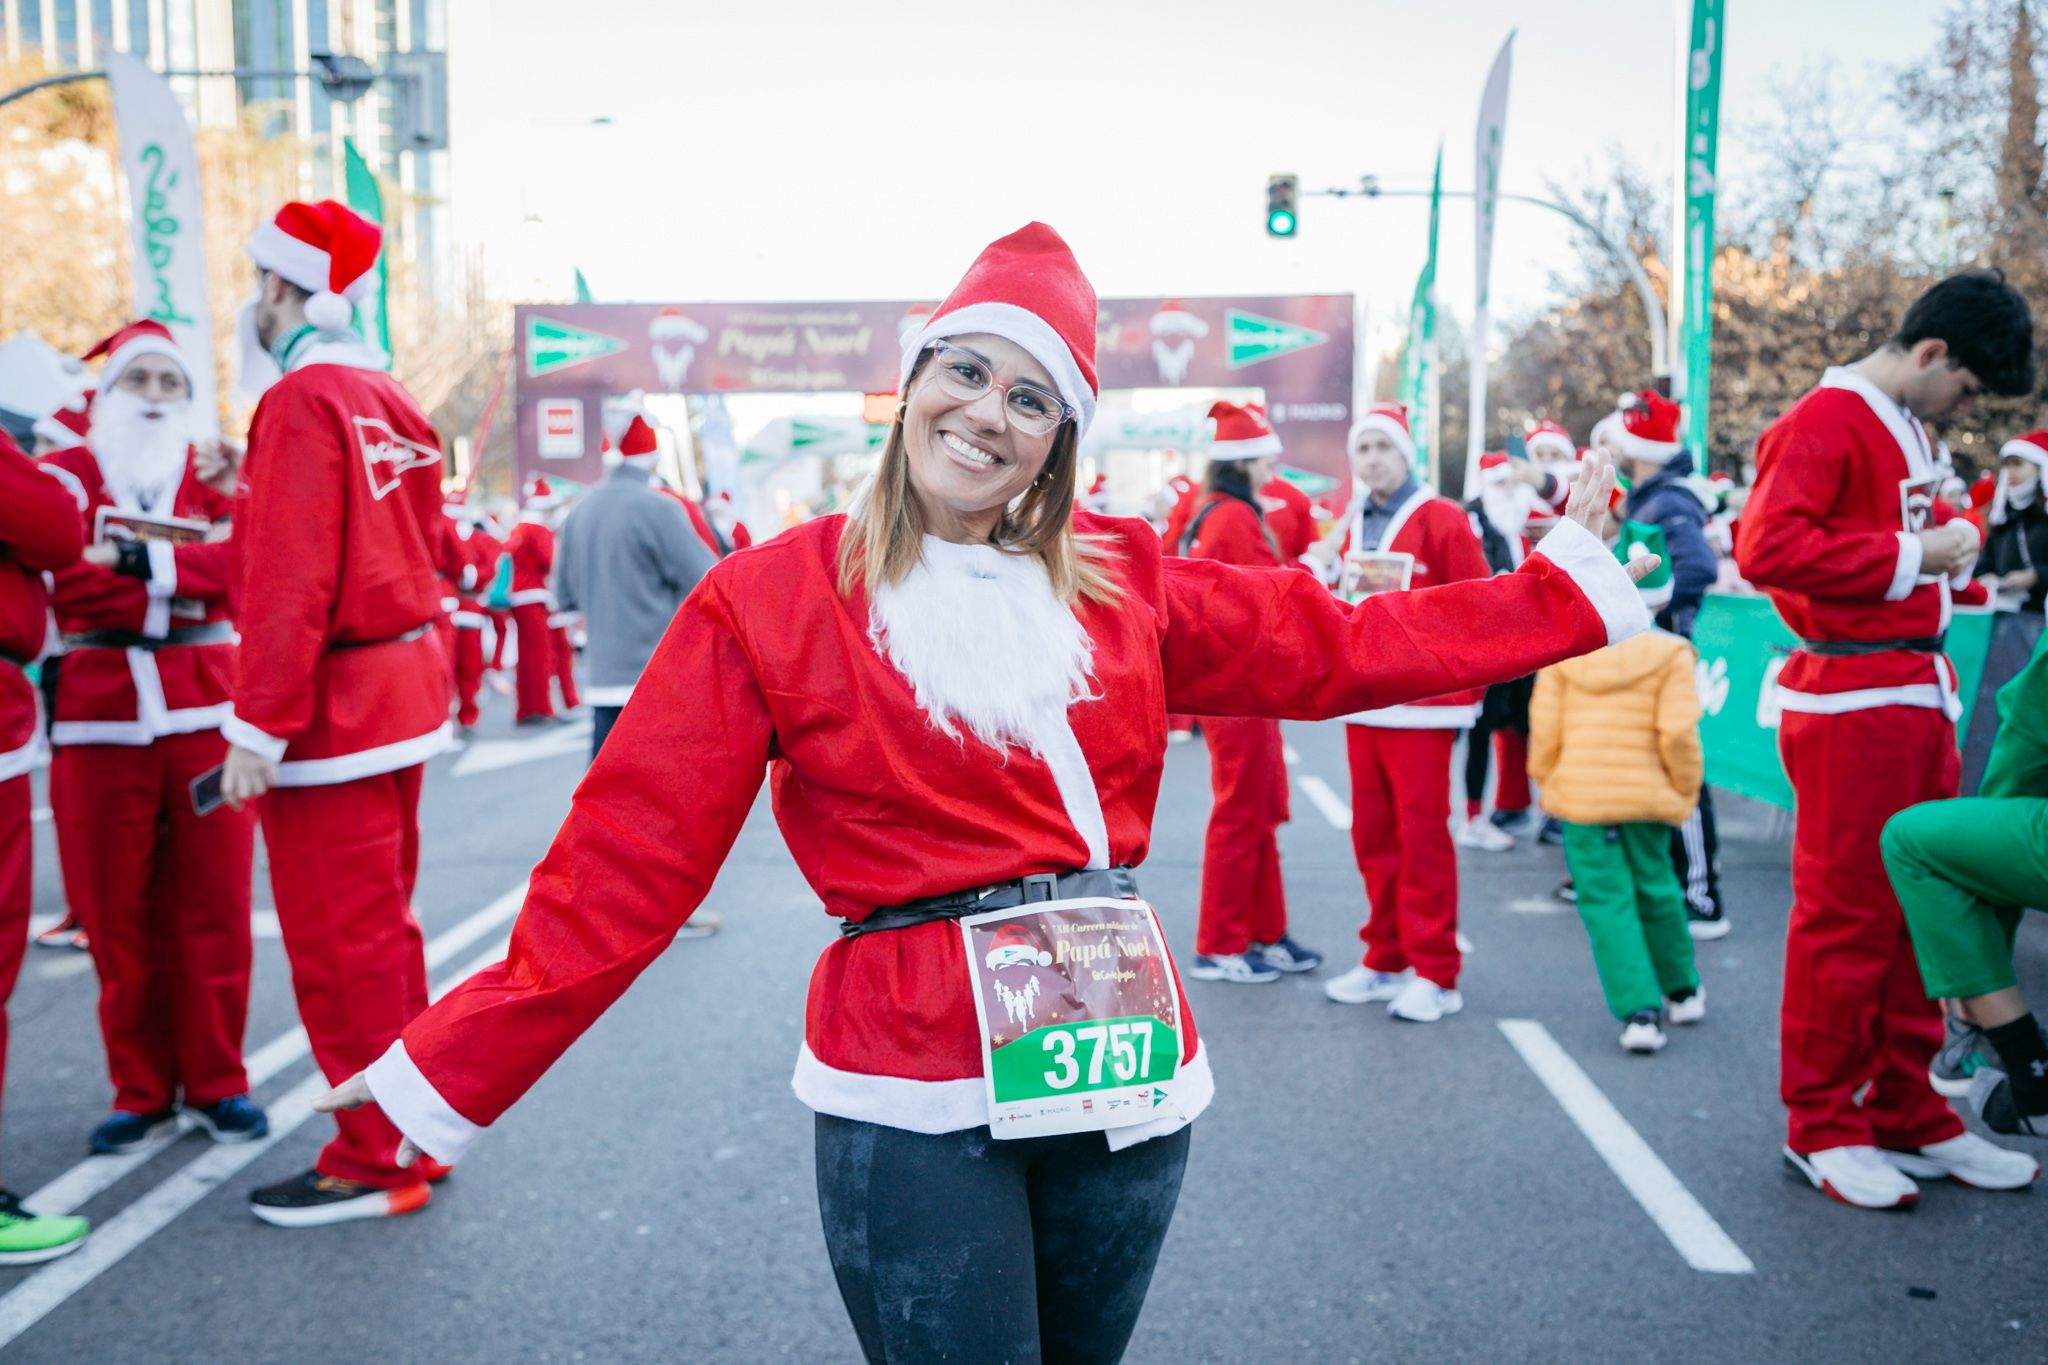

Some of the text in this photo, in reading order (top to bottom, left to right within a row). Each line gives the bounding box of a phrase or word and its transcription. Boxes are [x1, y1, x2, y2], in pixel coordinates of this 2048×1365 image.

[1071, 920, 1105, 933] Carrera
[1056, 935, 1151, 968] Papá Noel
[1042, 1022, 1152, 1089] 3757
